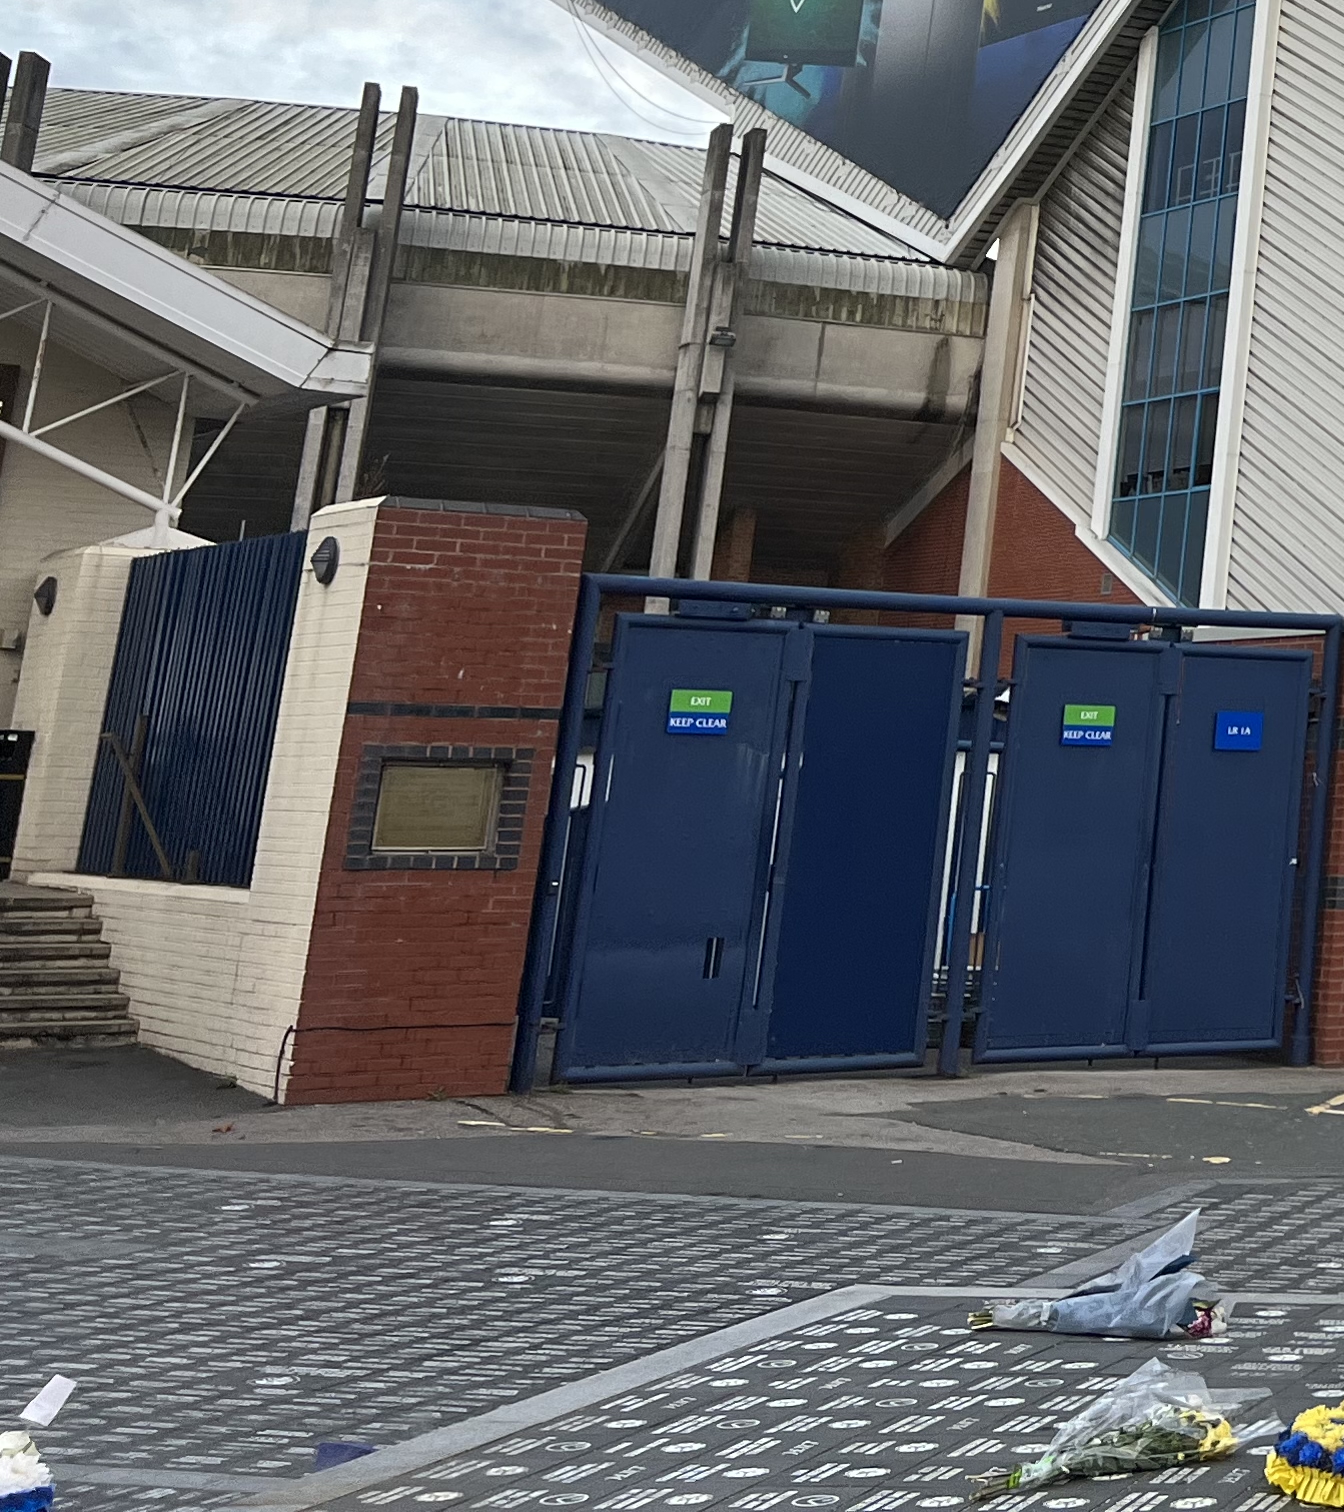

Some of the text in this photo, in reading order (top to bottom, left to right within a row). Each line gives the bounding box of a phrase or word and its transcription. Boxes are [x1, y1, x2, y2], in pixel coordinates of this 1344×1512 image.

[691, 696, 712, 706] EXIT
[1081, 710, 1098, 720] EXIT
[670, 717, 727, 728] KEEP CLEAR
[1063, 730, 1112, 740] KEEP CLEAR
